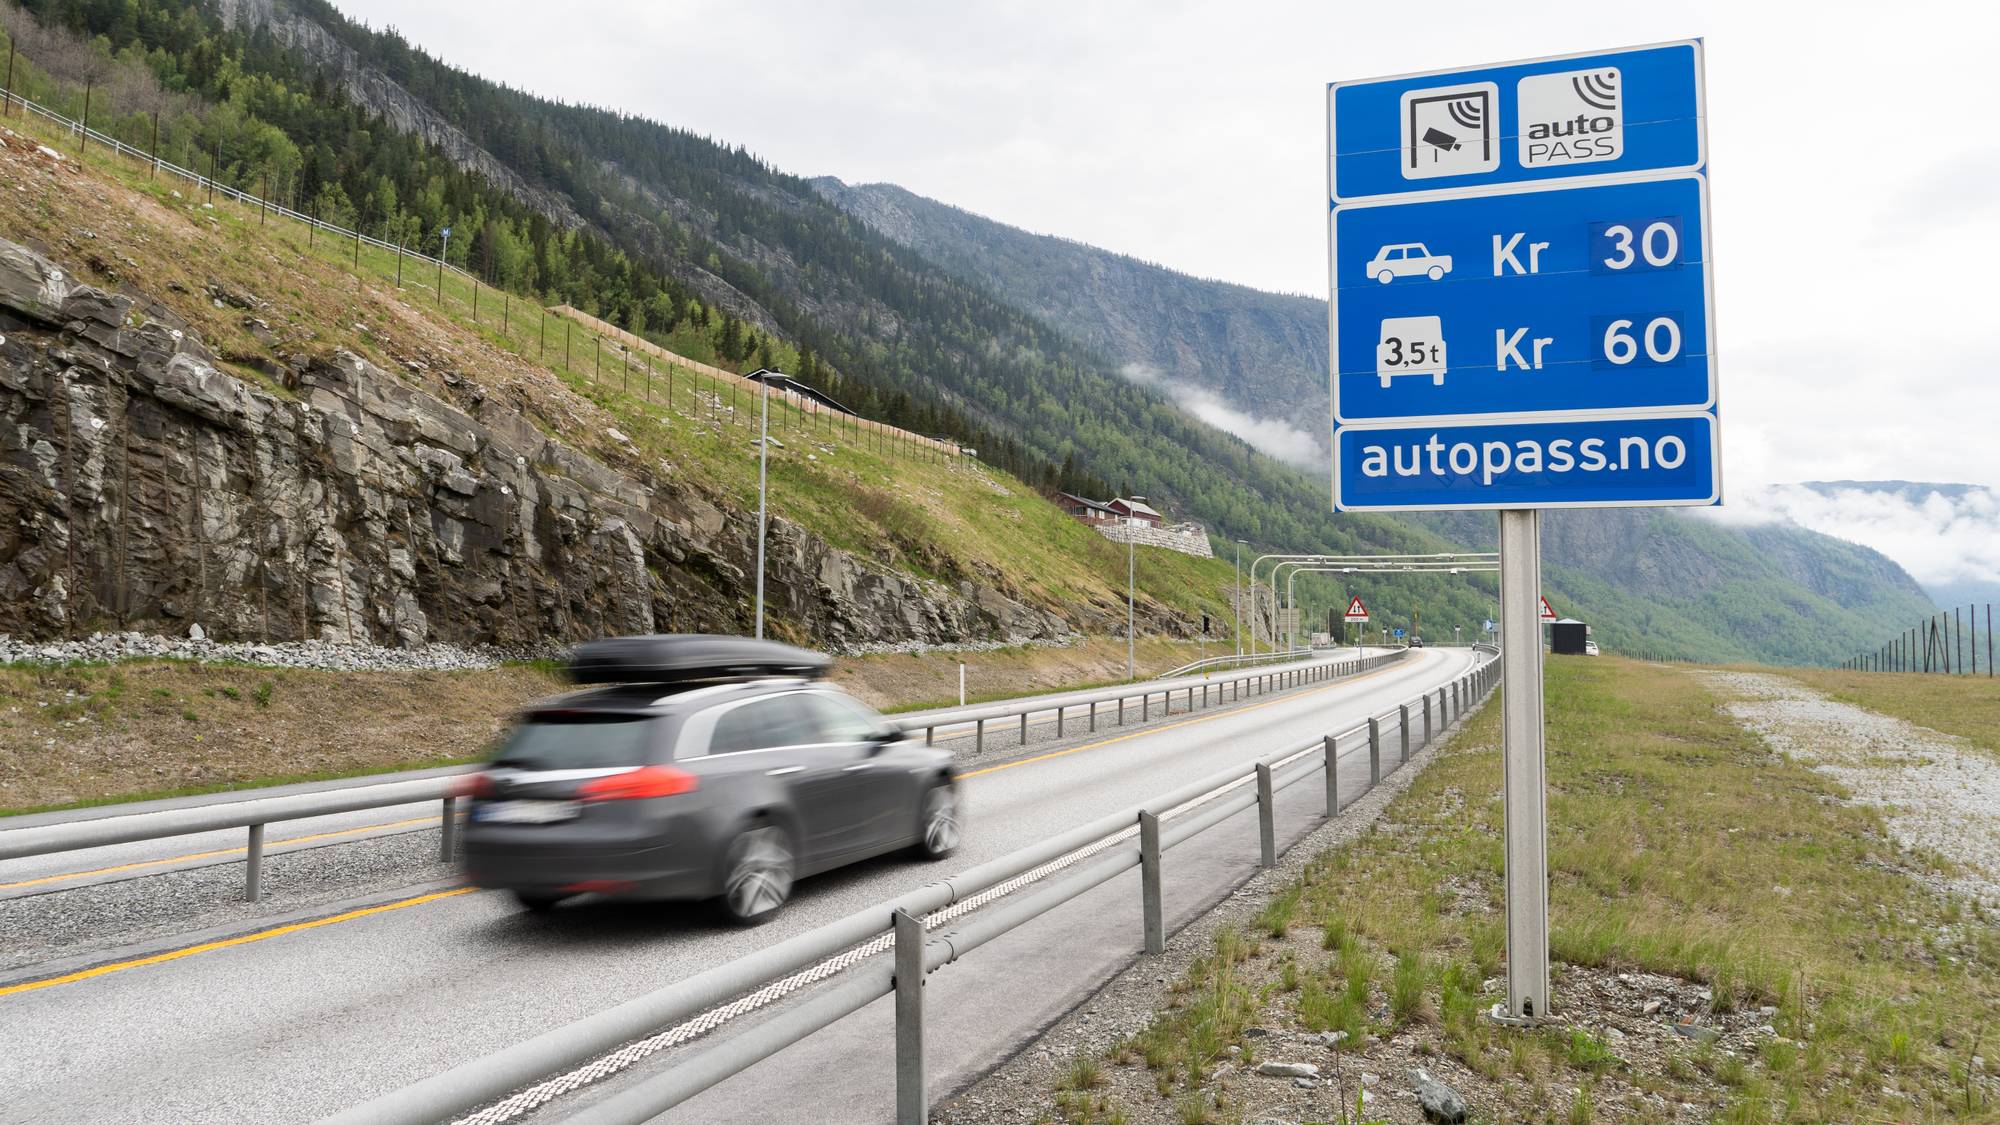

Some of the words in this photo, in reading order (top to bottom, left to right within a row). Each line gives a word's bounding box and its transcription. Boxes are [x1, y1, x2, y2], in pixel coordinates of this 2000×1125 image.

[1529, 115, 1615, 140] auto
[1529, 137, 1615, 164] PASS
[1492, 232, 1550, 277] Kr
[1604, 222, 1679, 270] 30
[1495, 327, 1554, 372] Kr
[1603, 317, 1681, 365] 60
[1361, 433, 1686, 486] autopass.no
